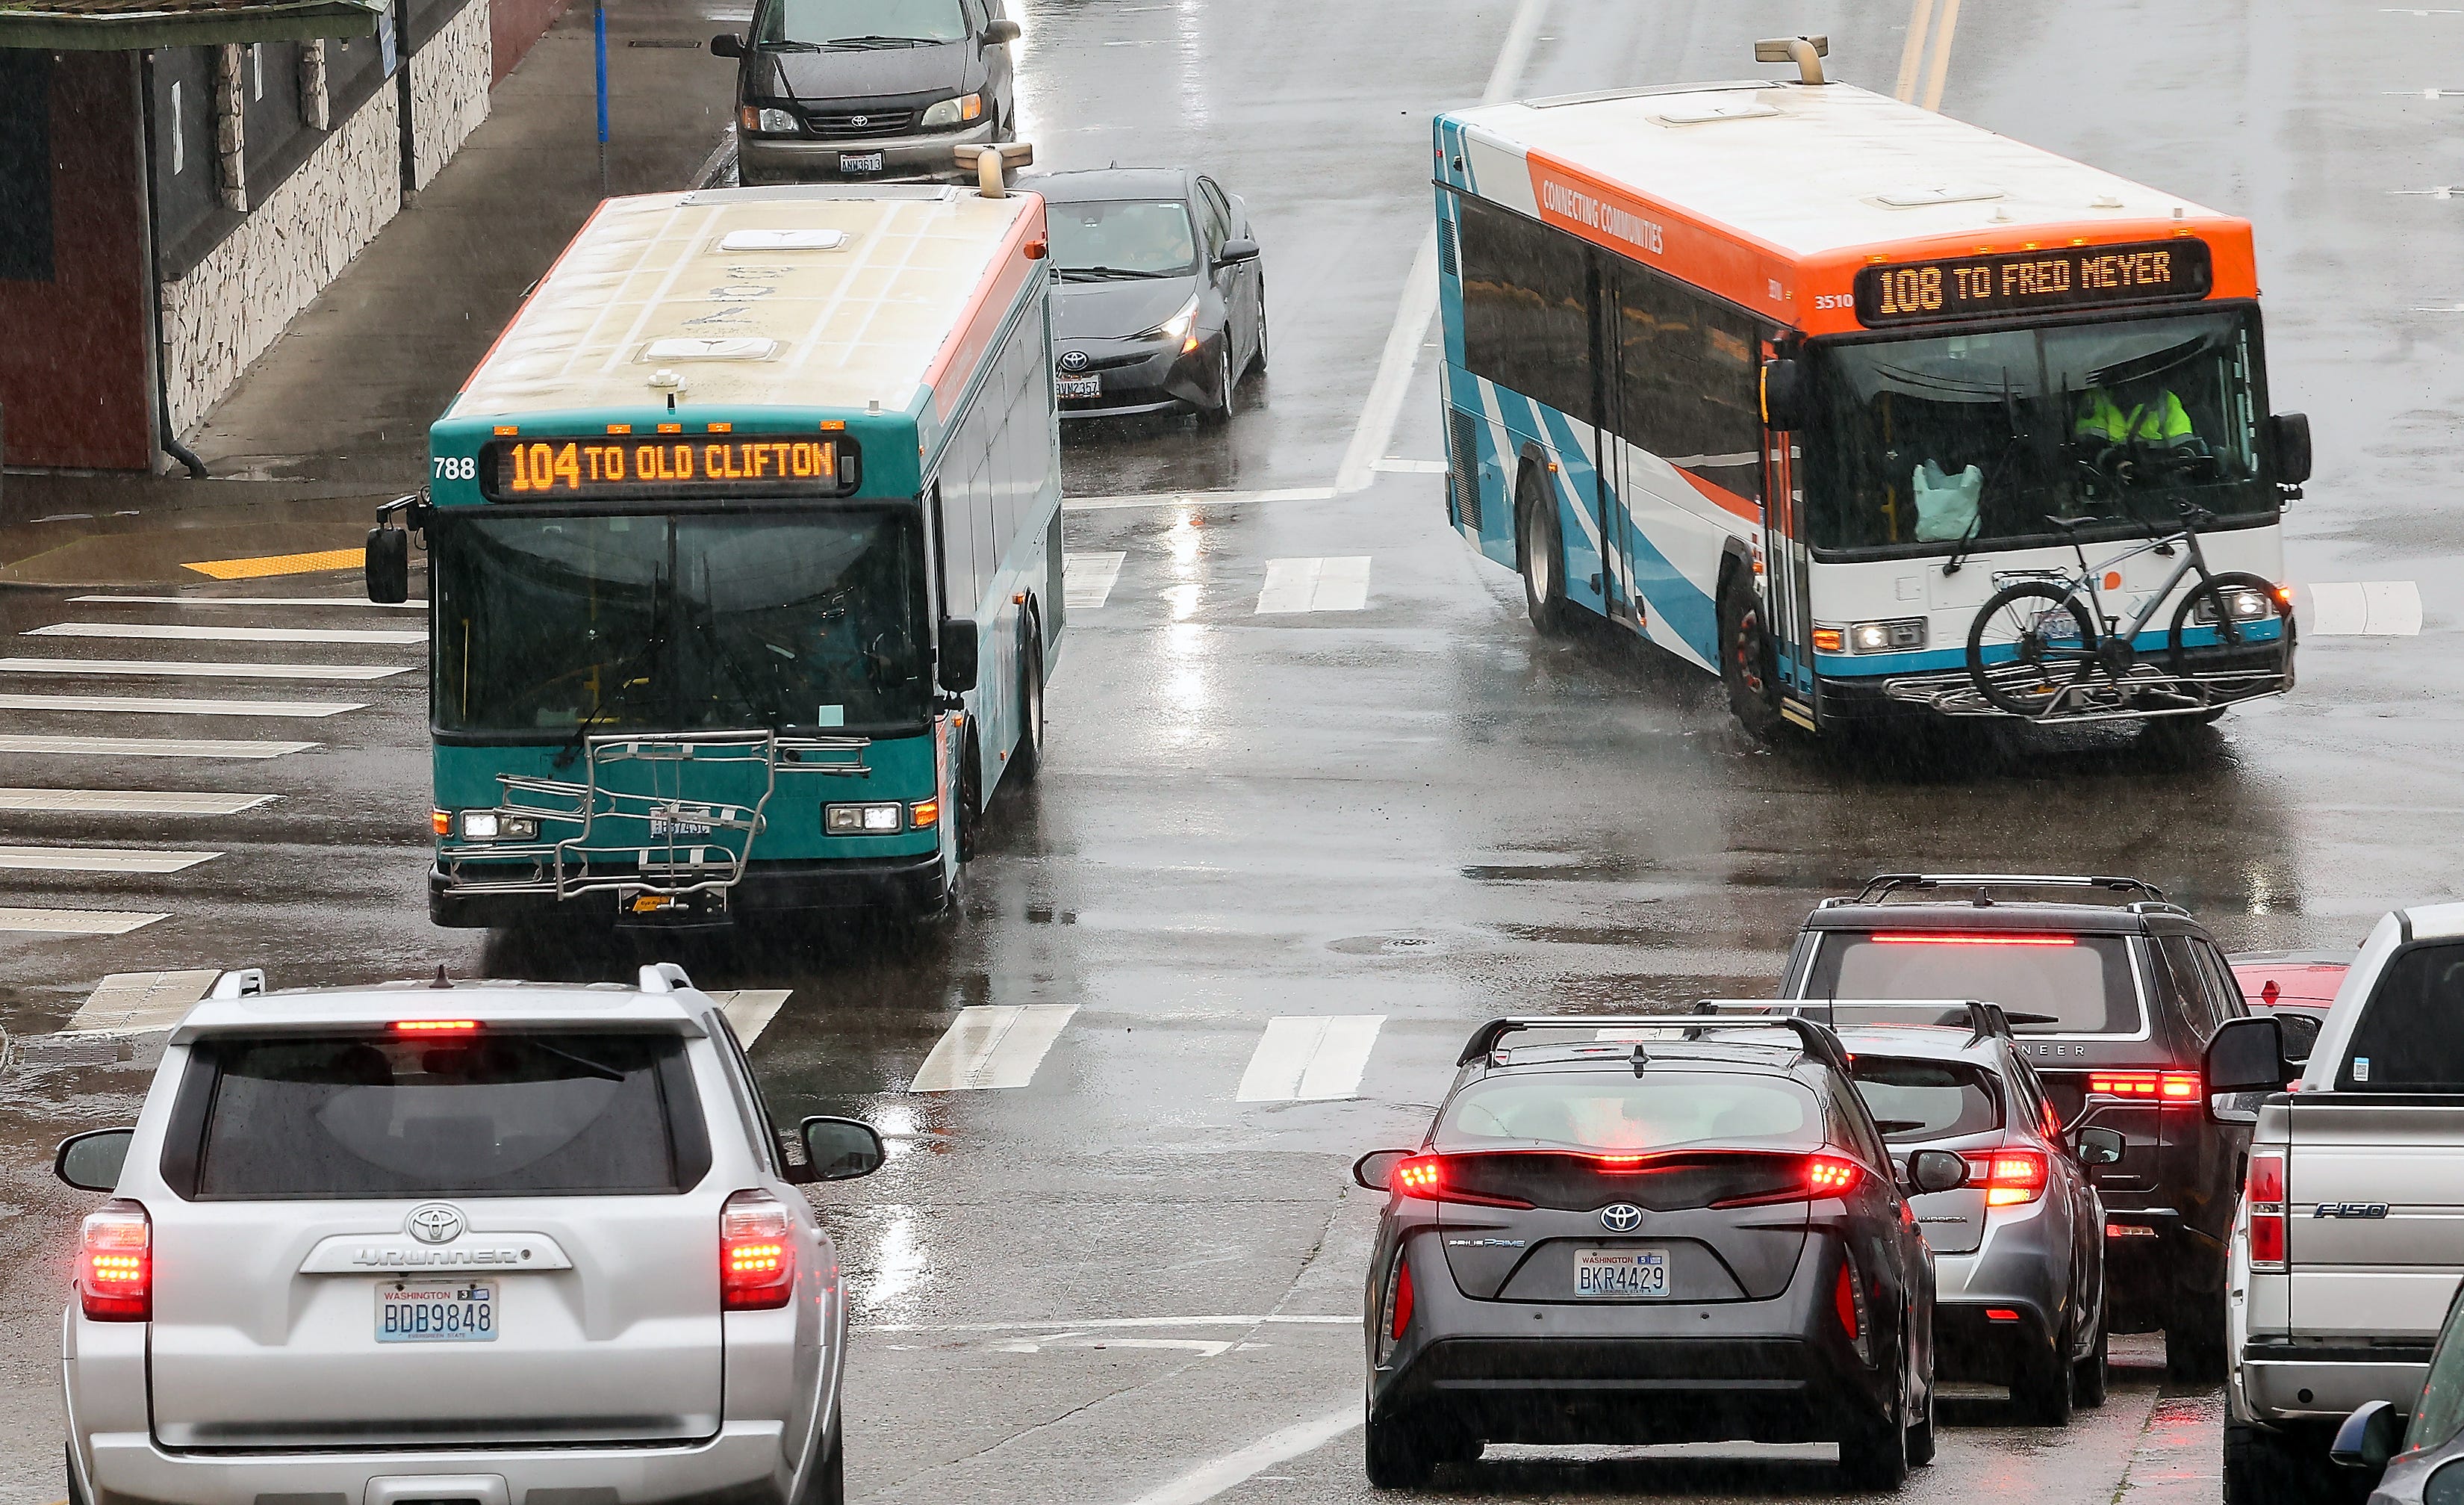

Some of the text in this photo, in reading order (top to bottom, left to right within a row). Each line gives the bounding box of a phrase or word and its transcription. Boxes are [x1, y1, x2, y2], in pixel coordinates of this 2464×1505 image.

[1543, 179, 1664, 255] CONNECTING COMMUNITIES
[1879, 251, 2171, 314] 108 TO FRED MEYER
[1814, 294, 1854, 309] 3510
[433, 456, 476, 480] 788
[511, 442, 834, 491] 104 TO OLD CLIFTON
[1581, 1267, 1664, 1289] BKR4429
[385, 1291, 451, 1300] WASHINGTON
[385, 1303, 491, 1332] BDB9848
